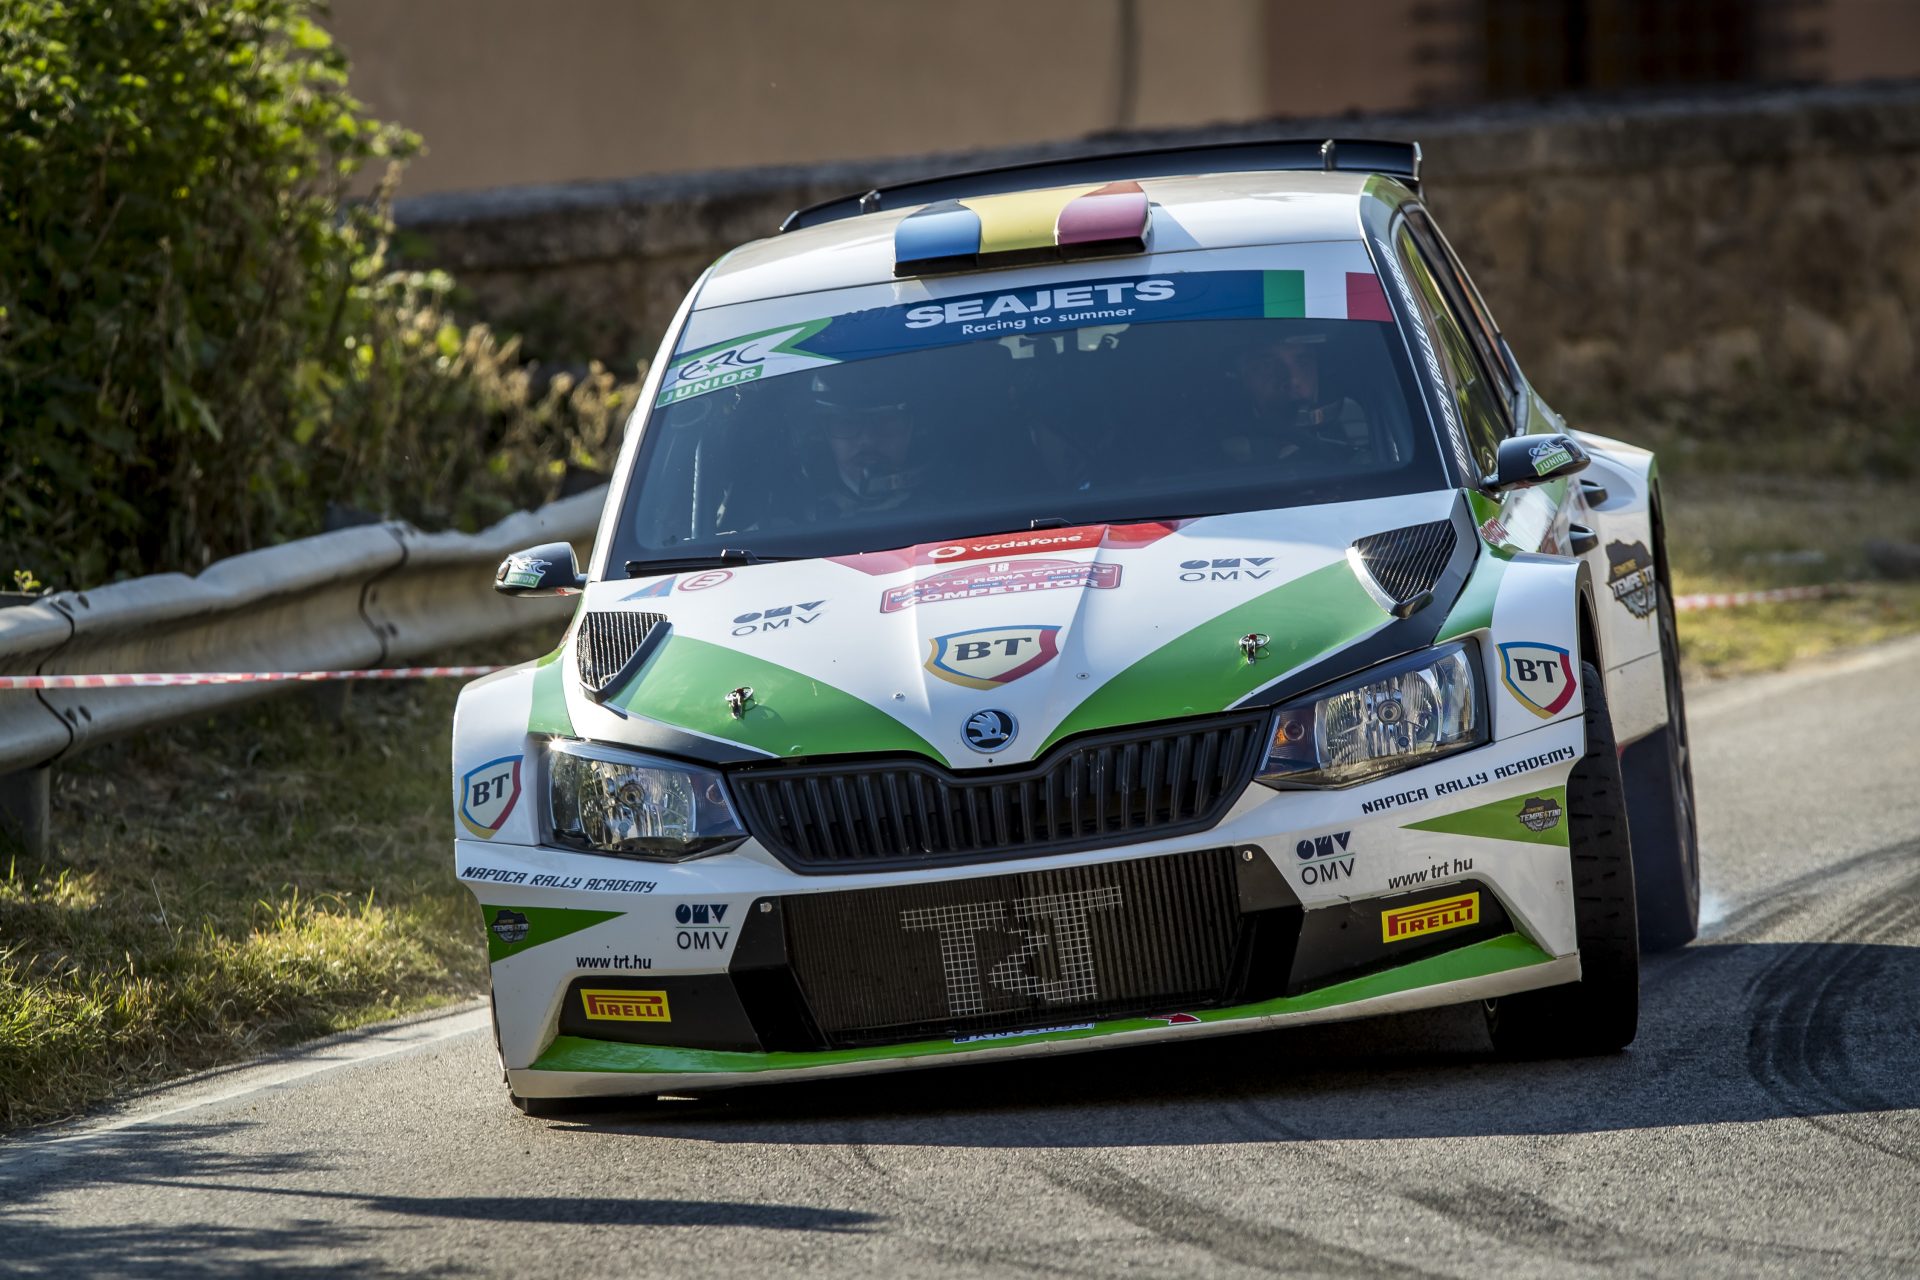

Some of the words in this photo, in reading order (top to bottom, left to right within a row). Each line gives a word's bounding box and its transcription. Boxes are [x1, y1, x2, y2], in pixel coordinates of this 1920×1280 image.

[1375, 237, 1423, 327] ACADEMY
[905, 280, 1176, 329] SEAJETS
[962, 317, 1027, 335] Racing
[1033, 314, 1052, 326] to
[1058, 308, 1136, 323] summer
[1413, 324, 1447, 391] RALLY
[663, 368, 758, 403] JUNIOR
[1436, 390, 1471, 478] NAPOCA
[1538, 451, 1571, 472] JUNIOR
[972, 534, 1083, 552] vodafone
[988, 562, 1010, 575] 18
[1180, 570, 1272, 582] OMV
[891, 581, 947, 598] RALLY
[974, 573, 1026, 584] ROMA
[902, 578, 1099, 607] COMPETITOR
[732, 613, 820, 636] OMV
[955, 637, 1031, 661] BT
[1513, 658, 1559, 683] BT
[472, 773, 510, 807] BT
[1361, 787, 1428, 814] NAPOCA
[1435, 771, 1489, 796] RALLY
[1494, 745, 1576, 780] ACADEMY
[461, 866, 528, 883] NAPOCA
[530, 874, 583, 889] RALLY
[583, 877, 657, 894] ACADEMY
[1301, 857, 1355, 886] OMV
[1387, 898, 1474, 937] PIRELLI
[676, 931, 729, 950] OMV
[586, 994, 664, 1018] PIRELLI
